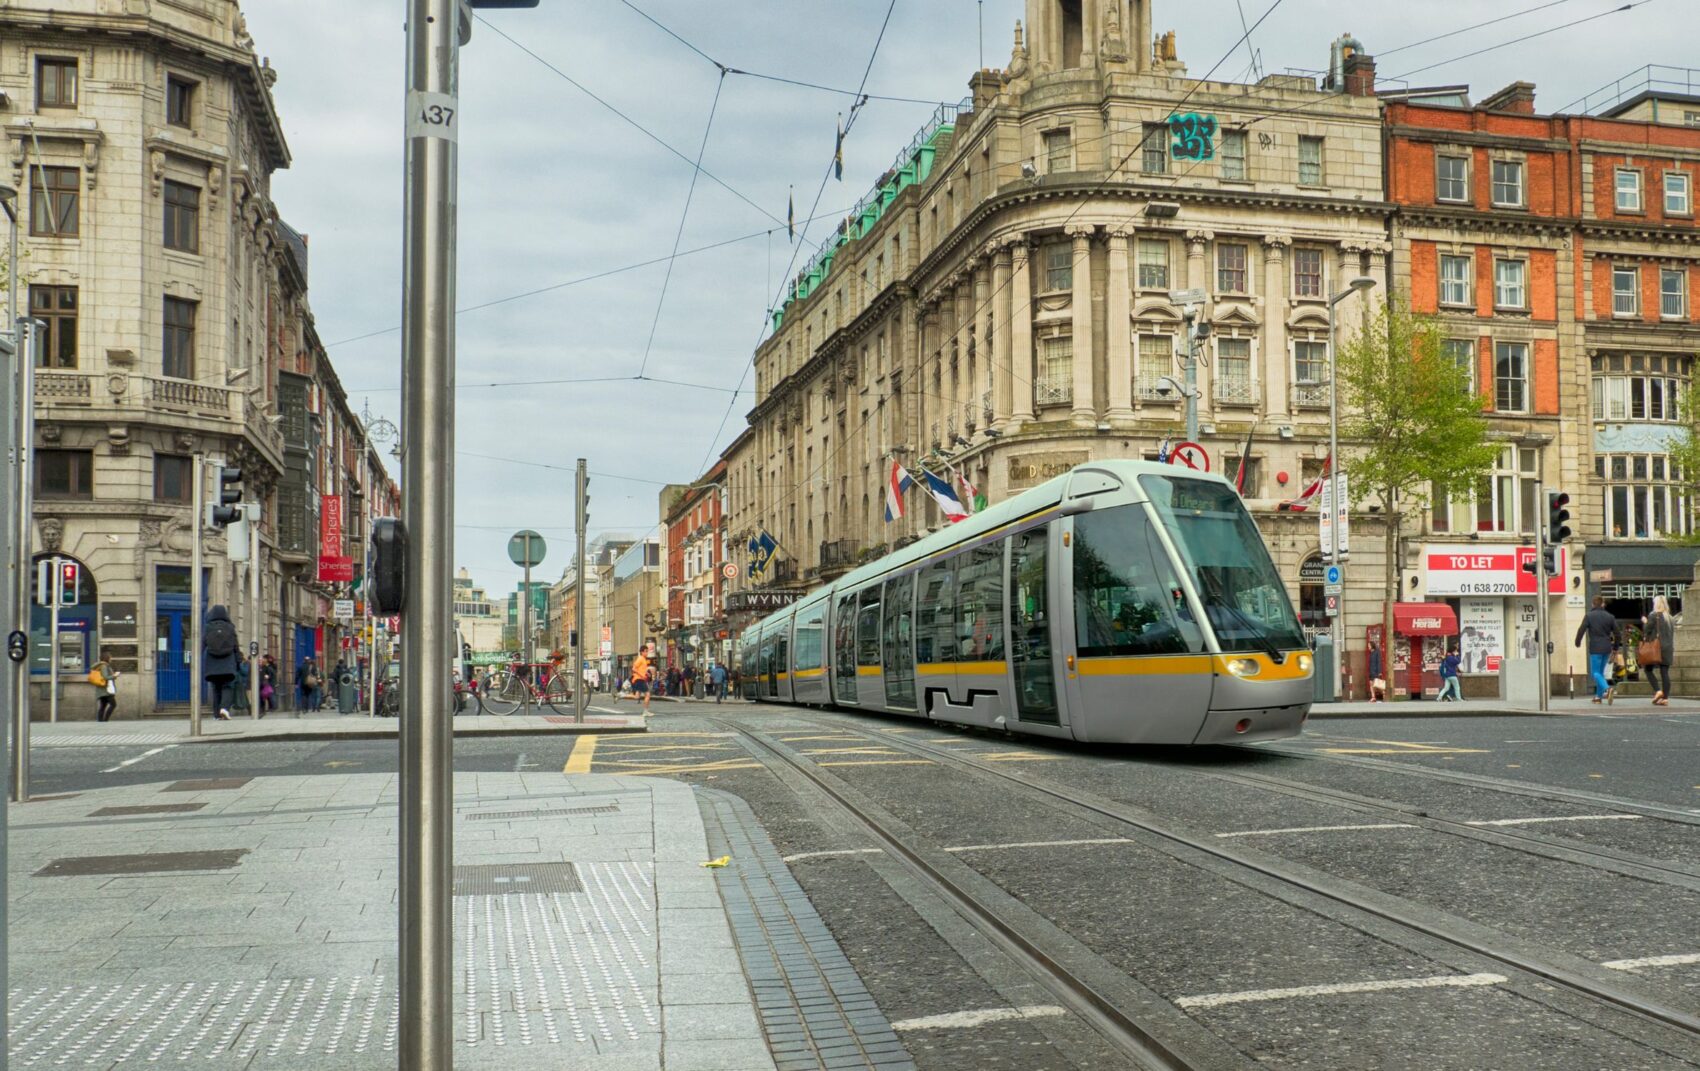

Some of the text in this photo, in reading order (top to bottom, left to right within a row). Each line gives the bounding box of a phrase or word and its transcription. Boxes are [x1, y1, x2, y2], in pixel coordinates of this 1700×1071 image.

[326, 498, 338, 542] Sheries
[320, 561, 351, 570] Sheries
[1450, 556, 1494, 569] TO LET
[1410, 576, 1419, 588] 9
[1573, 576, 1581, 588] 9
[1460, 583, 1516, 593] 01 638 2700
[1522, 604, 1534, 613] TO
[1412, 618, 1442, 629] Herald
[1521, 614, 1536, 622] LET
